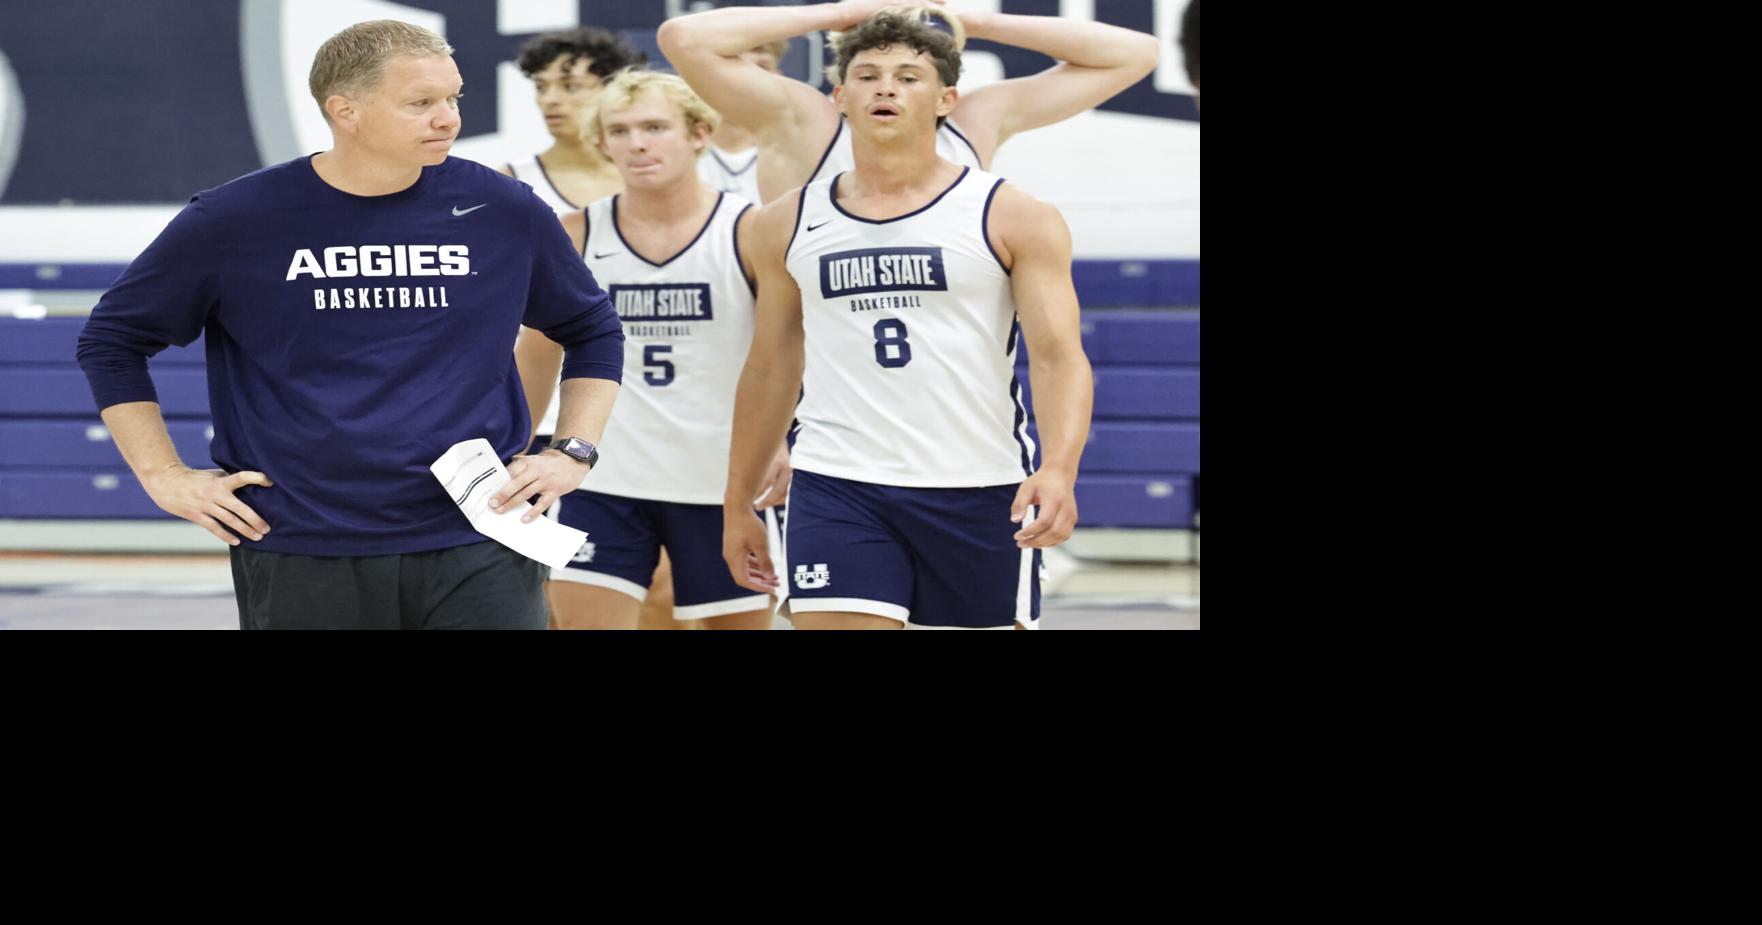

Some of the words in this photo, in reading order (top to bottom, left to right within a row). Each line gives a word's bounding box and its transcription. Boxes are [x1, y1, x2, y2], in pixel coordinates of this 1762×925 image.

[286, 245, 470, 281] AGGIES
[828, 256, 876, 291] UTAH
[878, 254, 936, 285] STATE
[314, 287, 449, 310] BASKETBALL
[615, 289, 655, 317] UTAH
[657, 289, 704, 316] STATE
[850, 296, 921, 312] BASKETBALL
[629, 325, 691, 336] BASKETBALL
[873, 318, 911, 368] 8
[643, 345, 675, 386] 5
